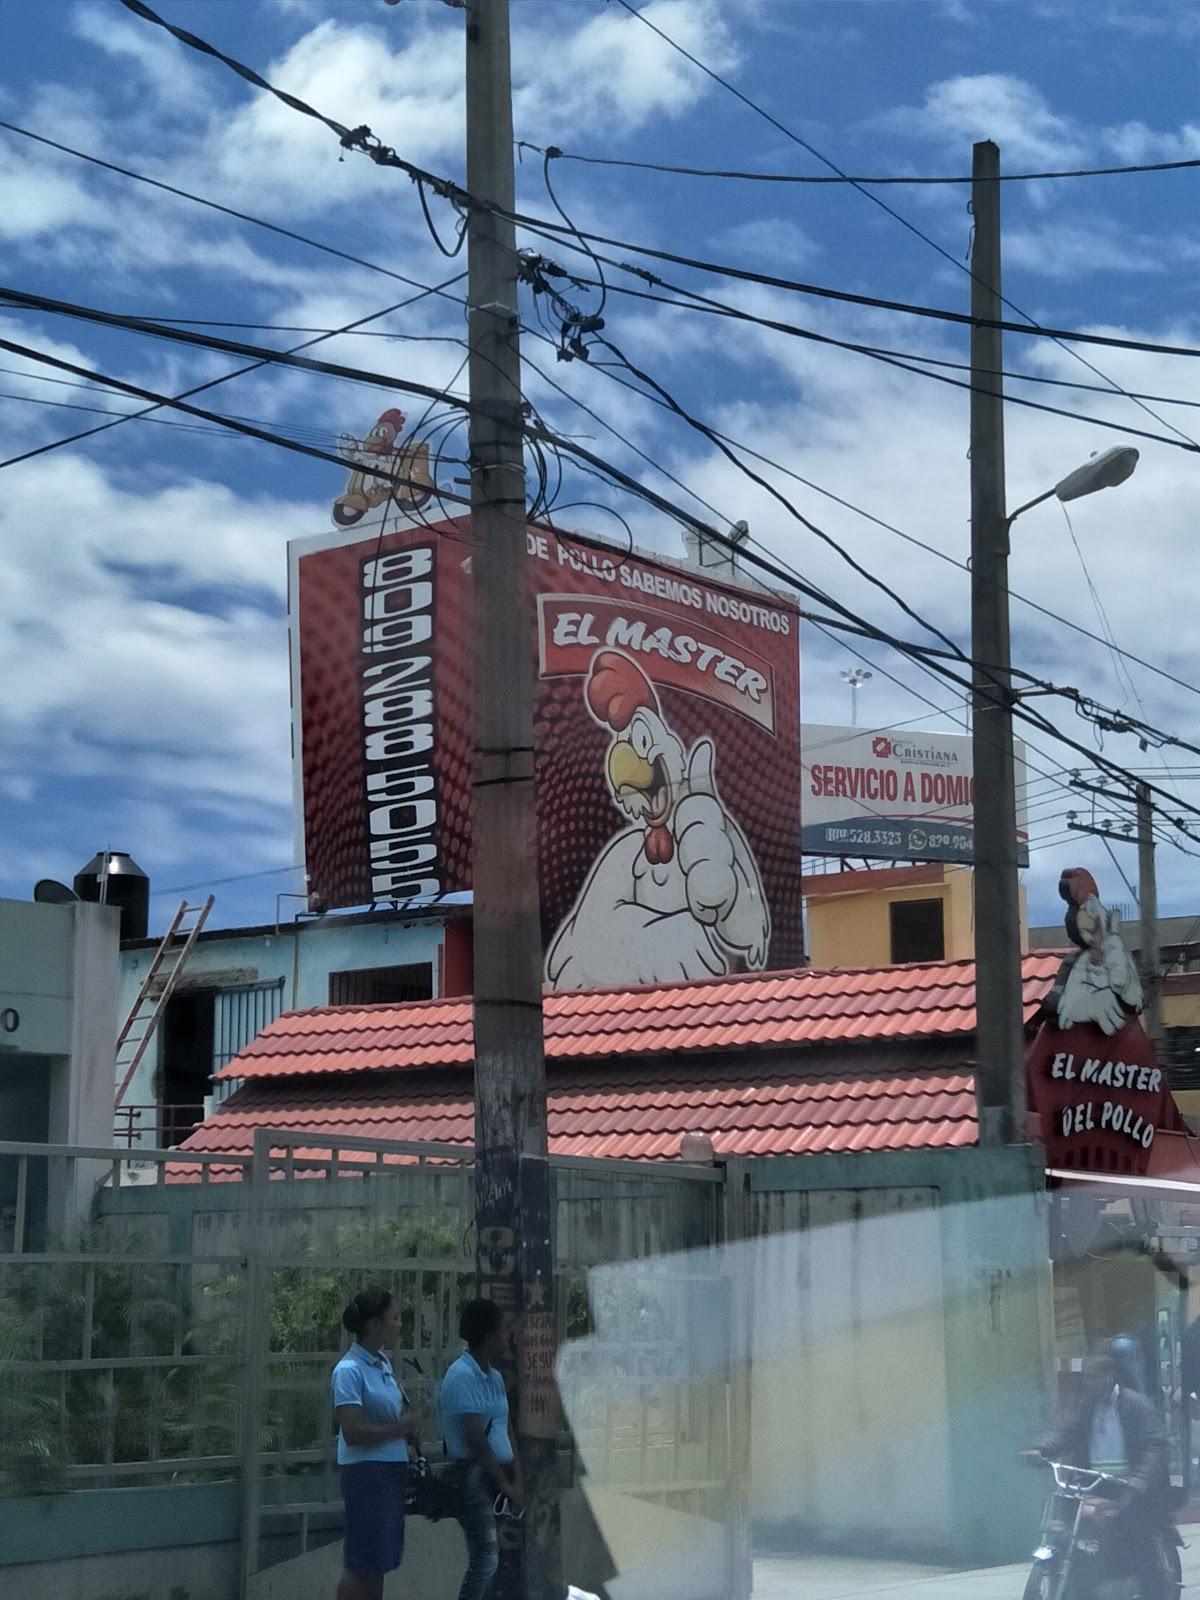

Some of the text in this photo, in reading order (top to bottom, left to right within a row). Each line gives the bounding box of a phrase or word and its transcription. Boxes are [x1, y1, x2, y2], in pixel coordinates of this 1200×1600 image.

[526, 533, 790, 636] DE POLLO SABEMOS NOSOTROS
[553, 612, 768, 704] EL MASTER
[362, 547, 440, 902] 809 288 5055
[810, 764, 898, 802] SERVICIO
[903, 771, 916, 803] A
[1052, 1052, 1162, 1093] EL MASTER
[1101, 1101, 1155, 1149] POLLO
